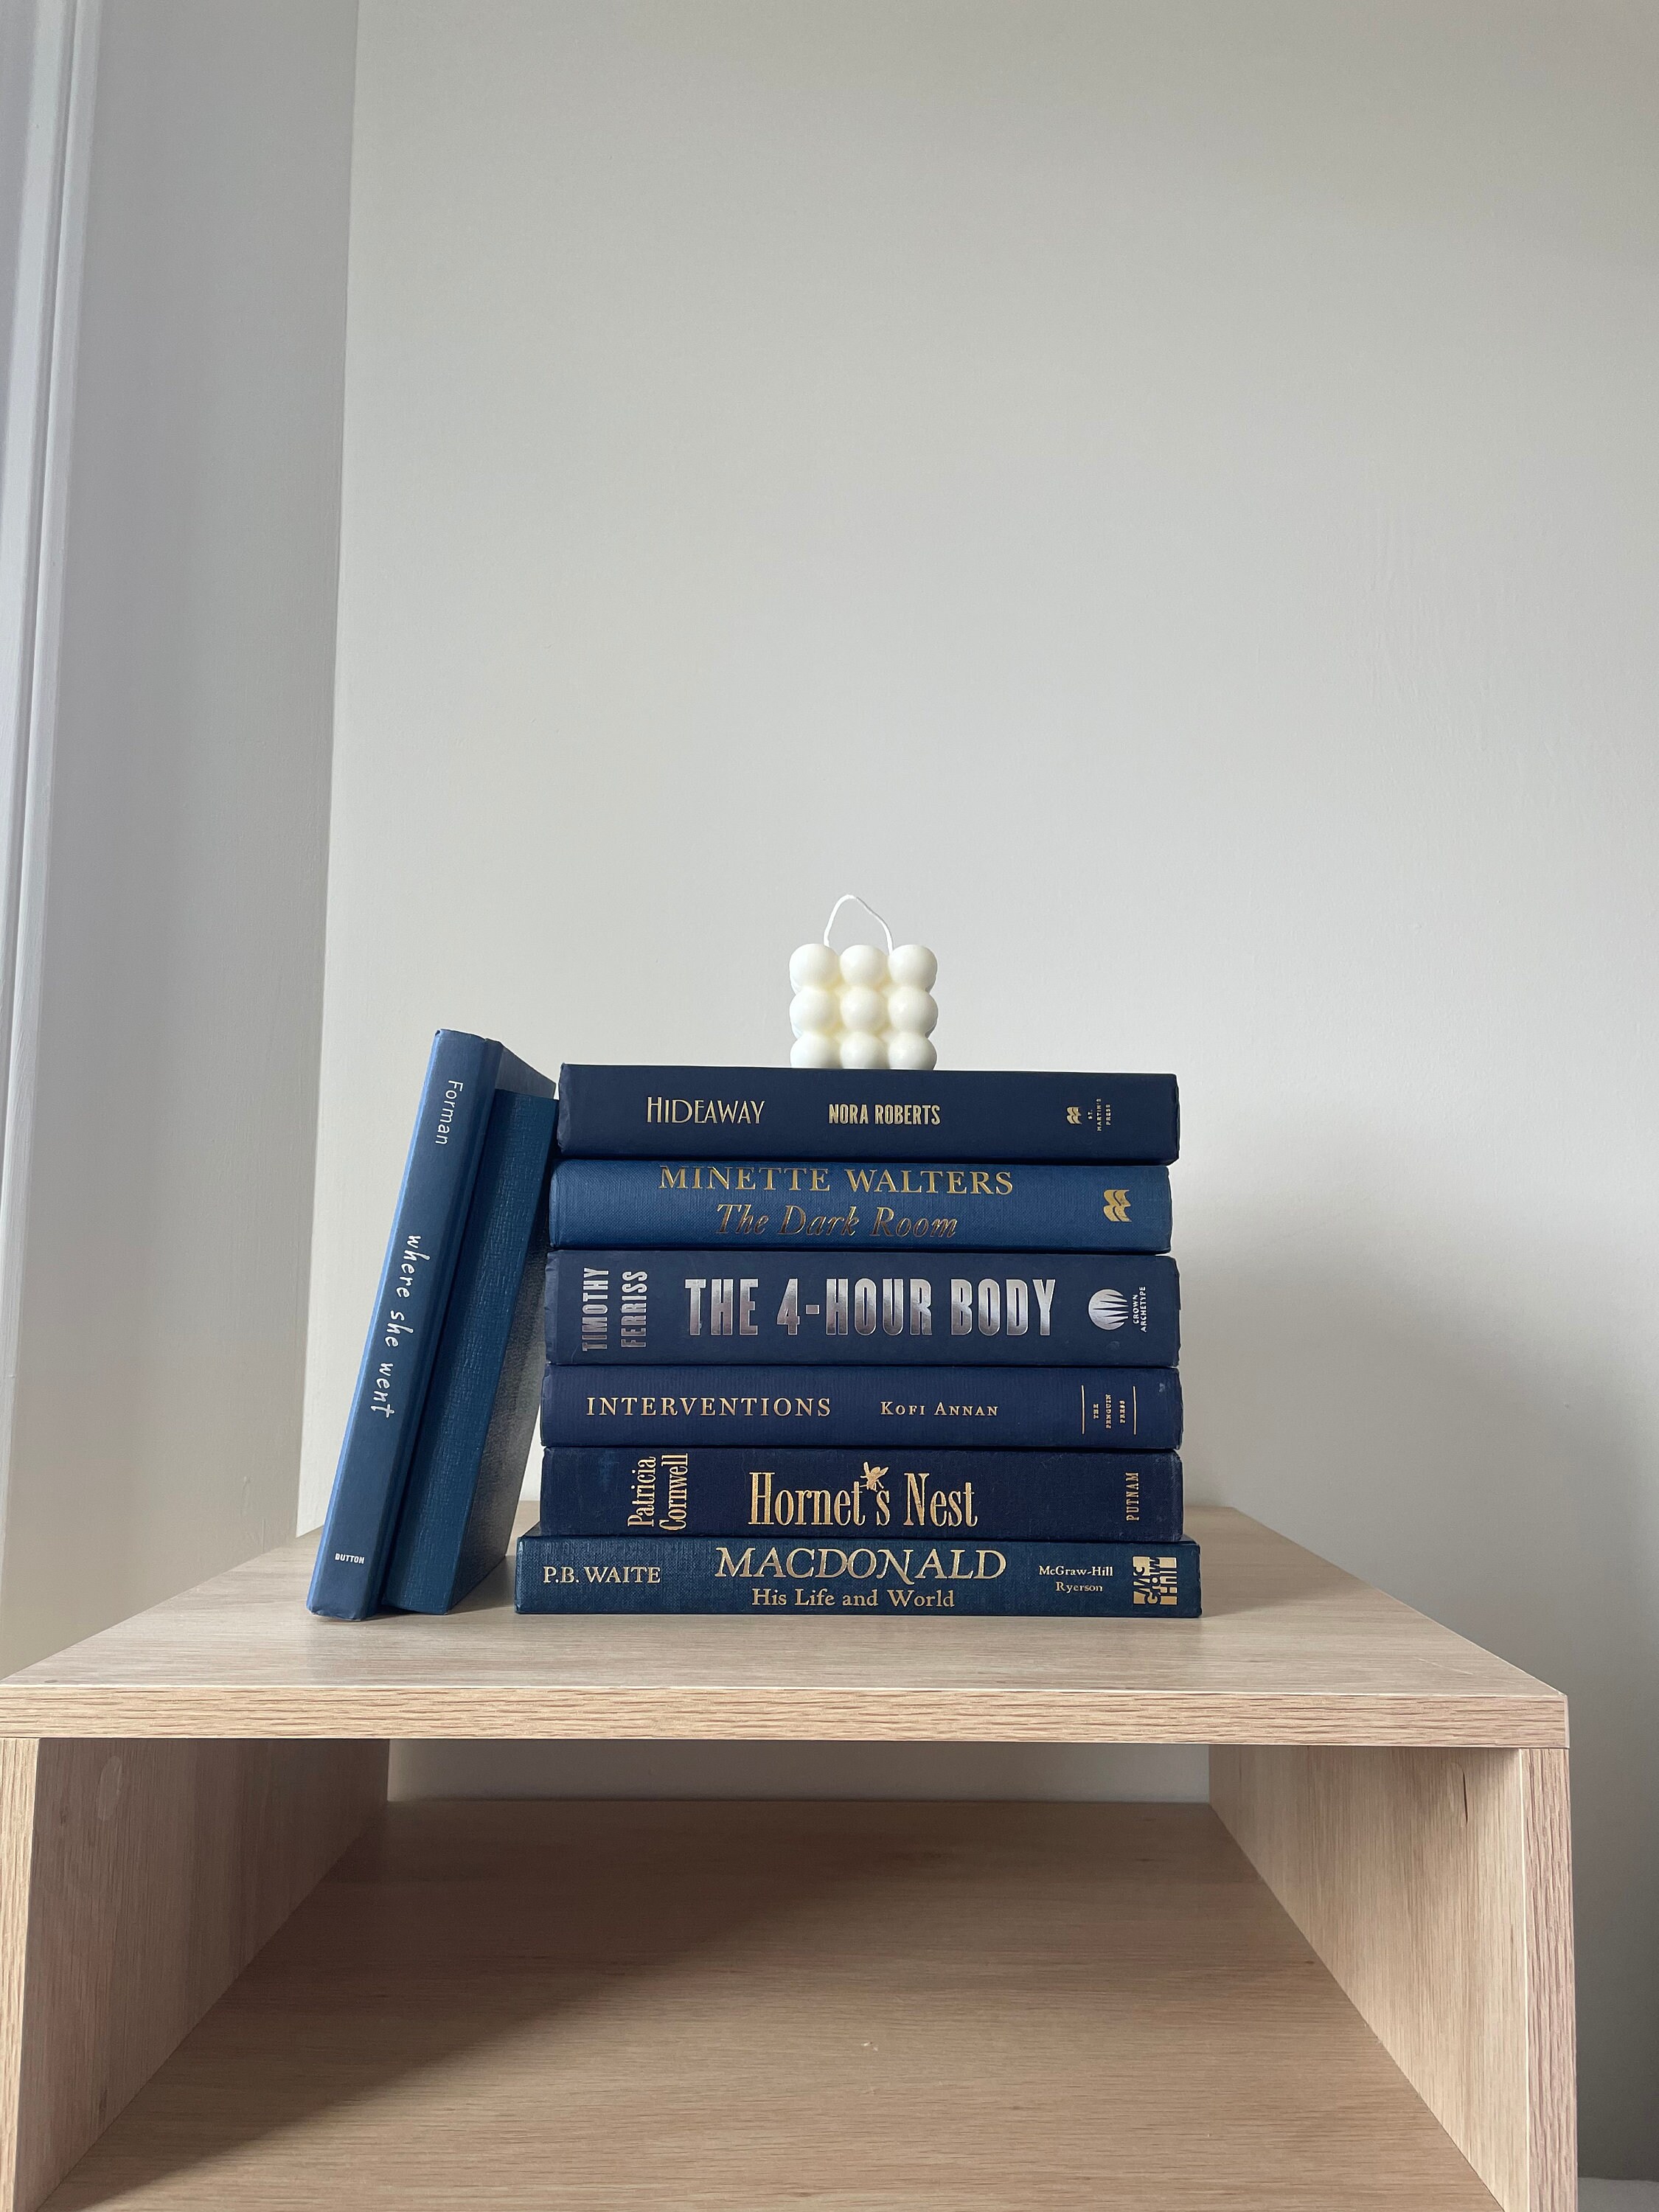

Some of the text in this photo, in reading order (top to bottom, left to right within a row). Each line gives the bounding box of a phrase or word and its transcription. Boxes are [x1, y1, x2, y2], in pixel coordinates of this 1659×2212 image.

[435, 1079, 464, 1144] Forman
[829, 1104, 941, 1125] NORA ROBERTS
[659, 1165, 1013, 1195] MINETTE WALTERS
[717, 1203, 958, 1238] The Dark Room
[370, 1235, 431, 1418] where she went
[582, 1267, 609, 1352] TIMOTHY
[621, 1271, 648, 1348] FERRISS
[684, 1278, 1056, 1336] THE 4-HOUR BODY
[1132, 1294, 1140, 1324] CROWN
[1138, 1286, 1147, 1333] ARCHETYPE
[586, 1397, 830, 1416] INTERVENTIONS
[627, 1456, 656, 1527] Patricia
[658, 1453, 688, 1531] Cornwell
[903, 1472, 978, 1527] Nest
[1125, 1472, 1140, 1521] PUTNAM
[335, 1553, 365, 1565] DUTTON
[543, 1566, 661, 1584] P.B. WAITE
[714, 1546, 1006, 1585] MACDONALD
[1039, 1565, 1113, 1576] McGraw-Hill
[751, 1587, 956, 1607] His Life and World
[1055, 1581, 1103, 1594] Ryerson
